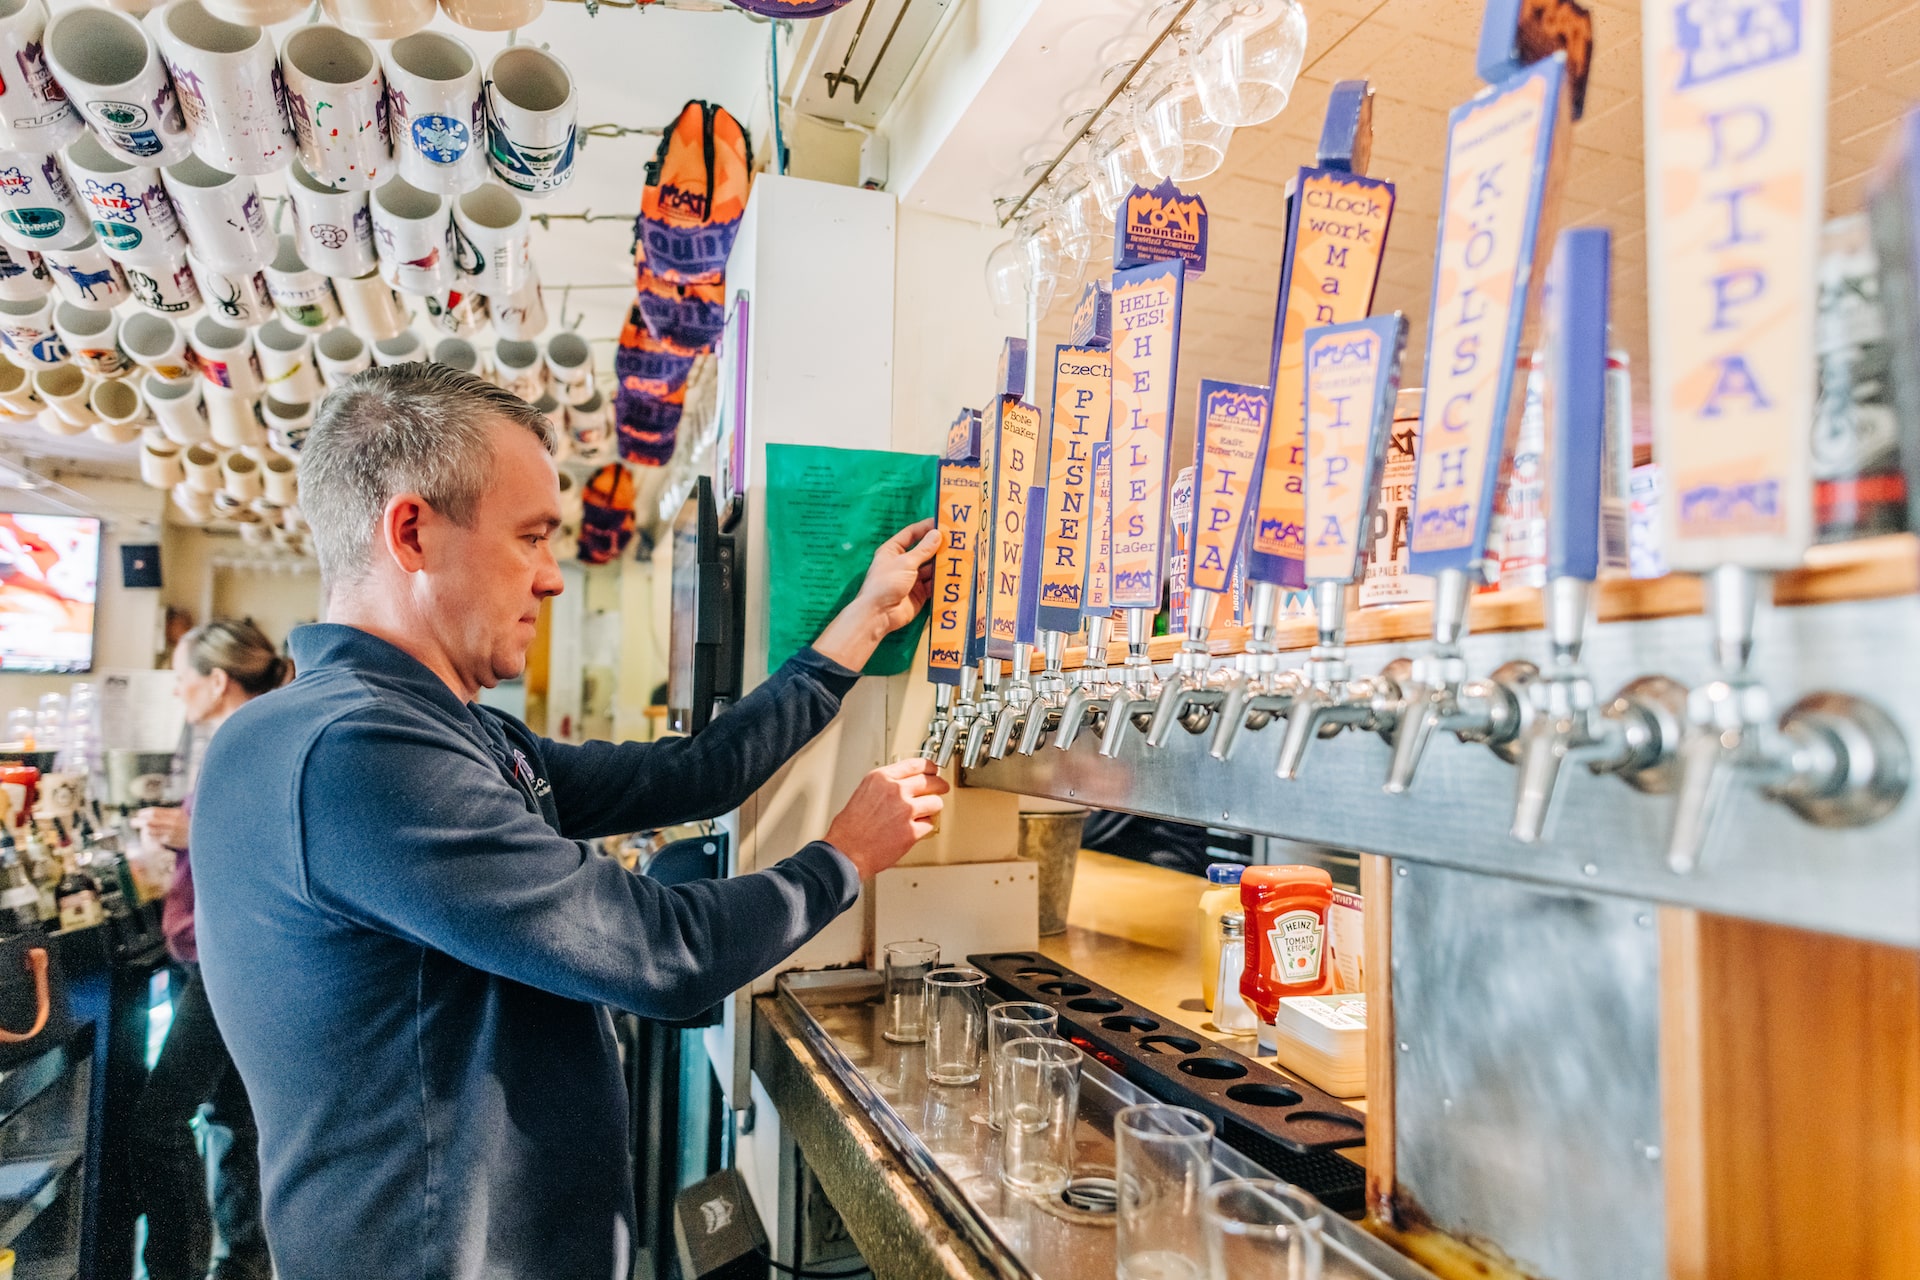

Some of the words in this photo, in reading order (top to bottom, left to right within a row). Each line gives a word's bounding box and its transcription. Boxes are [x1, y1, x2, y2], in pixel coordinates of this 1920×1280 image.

[91, 194, 131, 209] ALTA
[1127, 191, 1206, 234] MOAT
[1306, 189, 1381, 219] Clock
[1131, 225, 1195, 241] mountain
[1309, 218, 1371, 244] work
[1699, 102, 1773, 418] DIPA
[1119, 290, 1170, 315] HELL
[1124, 308, 1164, 331] YES!
[1210, 396, 1264, 422] MOAT
[1128, 335, 1152, 537] HELLES
[1056, 389, 1094, 567] PILSNER
[1316, 396, 1352, 546] IPA
[1000, 448, 1025, 597] BROWN
[1199, 469, 1237, 571] IPA
[940, 503, 972, 631] WEISS
[1043, 581, 1081, 603] MOAT
[1115, 570, 1154, 590] MOAT
[993, 617, 1016, 634] MOAT
[932, 648, 960, 663] MOAT
[1285, 921, 1312, 932] HEINZ
[1285, 935, 1314, 946] TOMATO
[1287, 944, 1313, 952] KETCHUP
